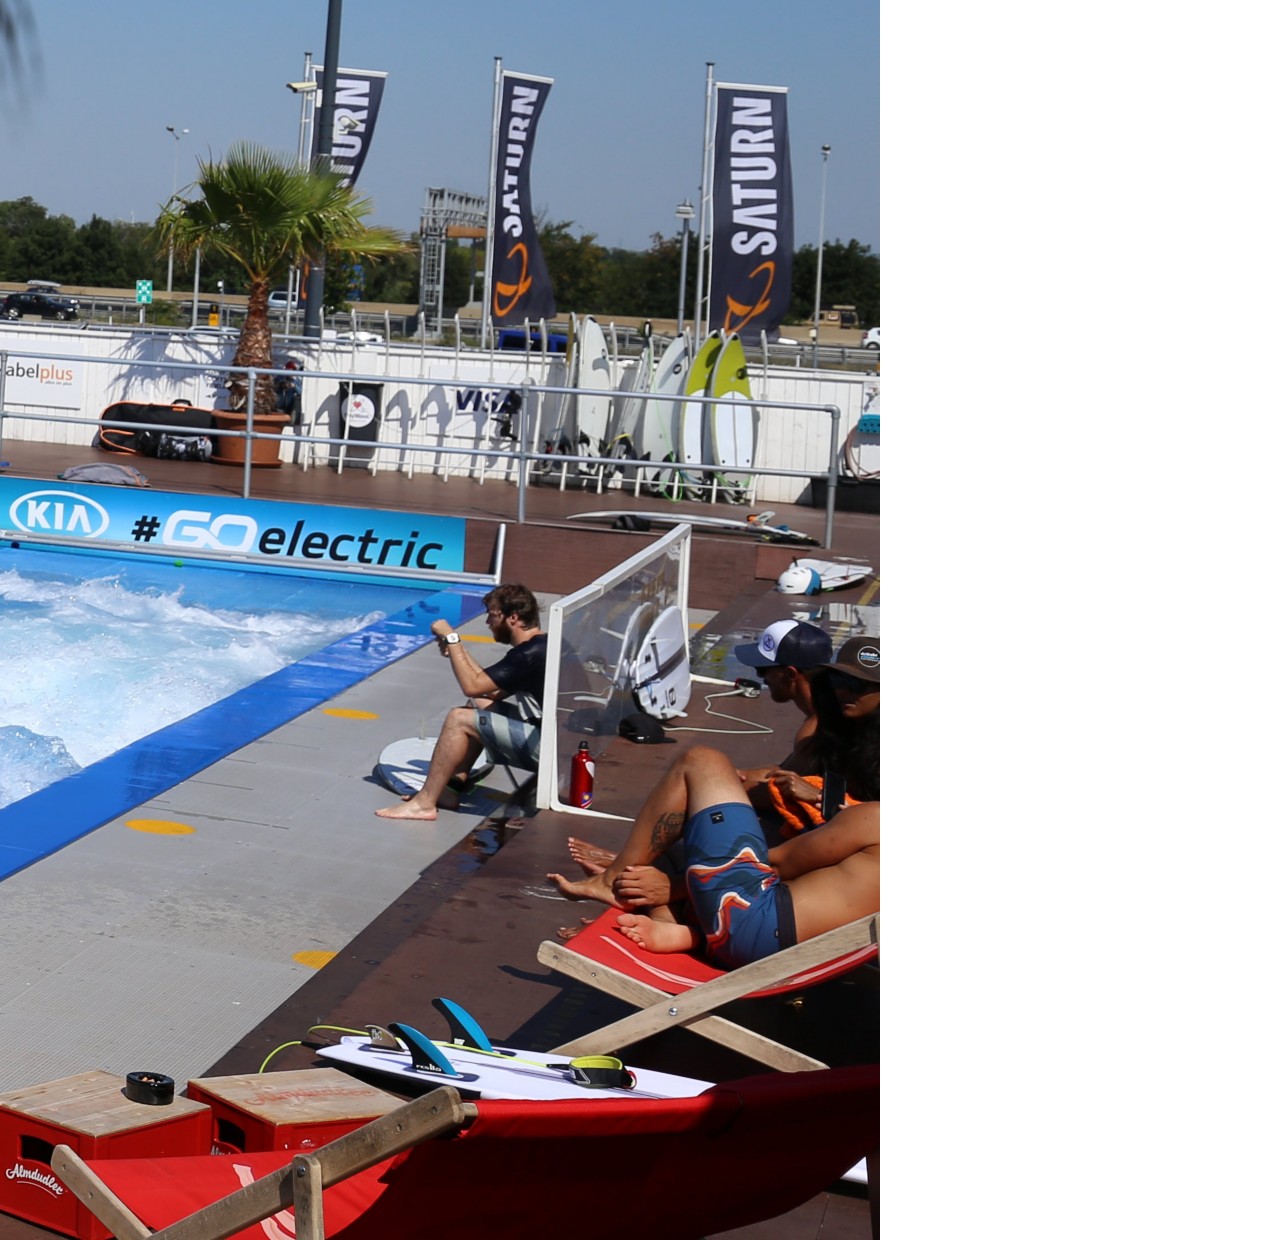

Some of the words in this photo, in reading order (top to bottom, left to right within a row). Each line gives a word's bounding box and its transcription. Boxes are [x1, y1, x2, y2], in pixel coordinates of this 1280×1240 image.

[502, 85, 539, 238] SATURN
[730, 96, 778, 256] SATURN
[26, 500, 92, 533] KIA
[5, 1163, 64, 1195] Almdudler
